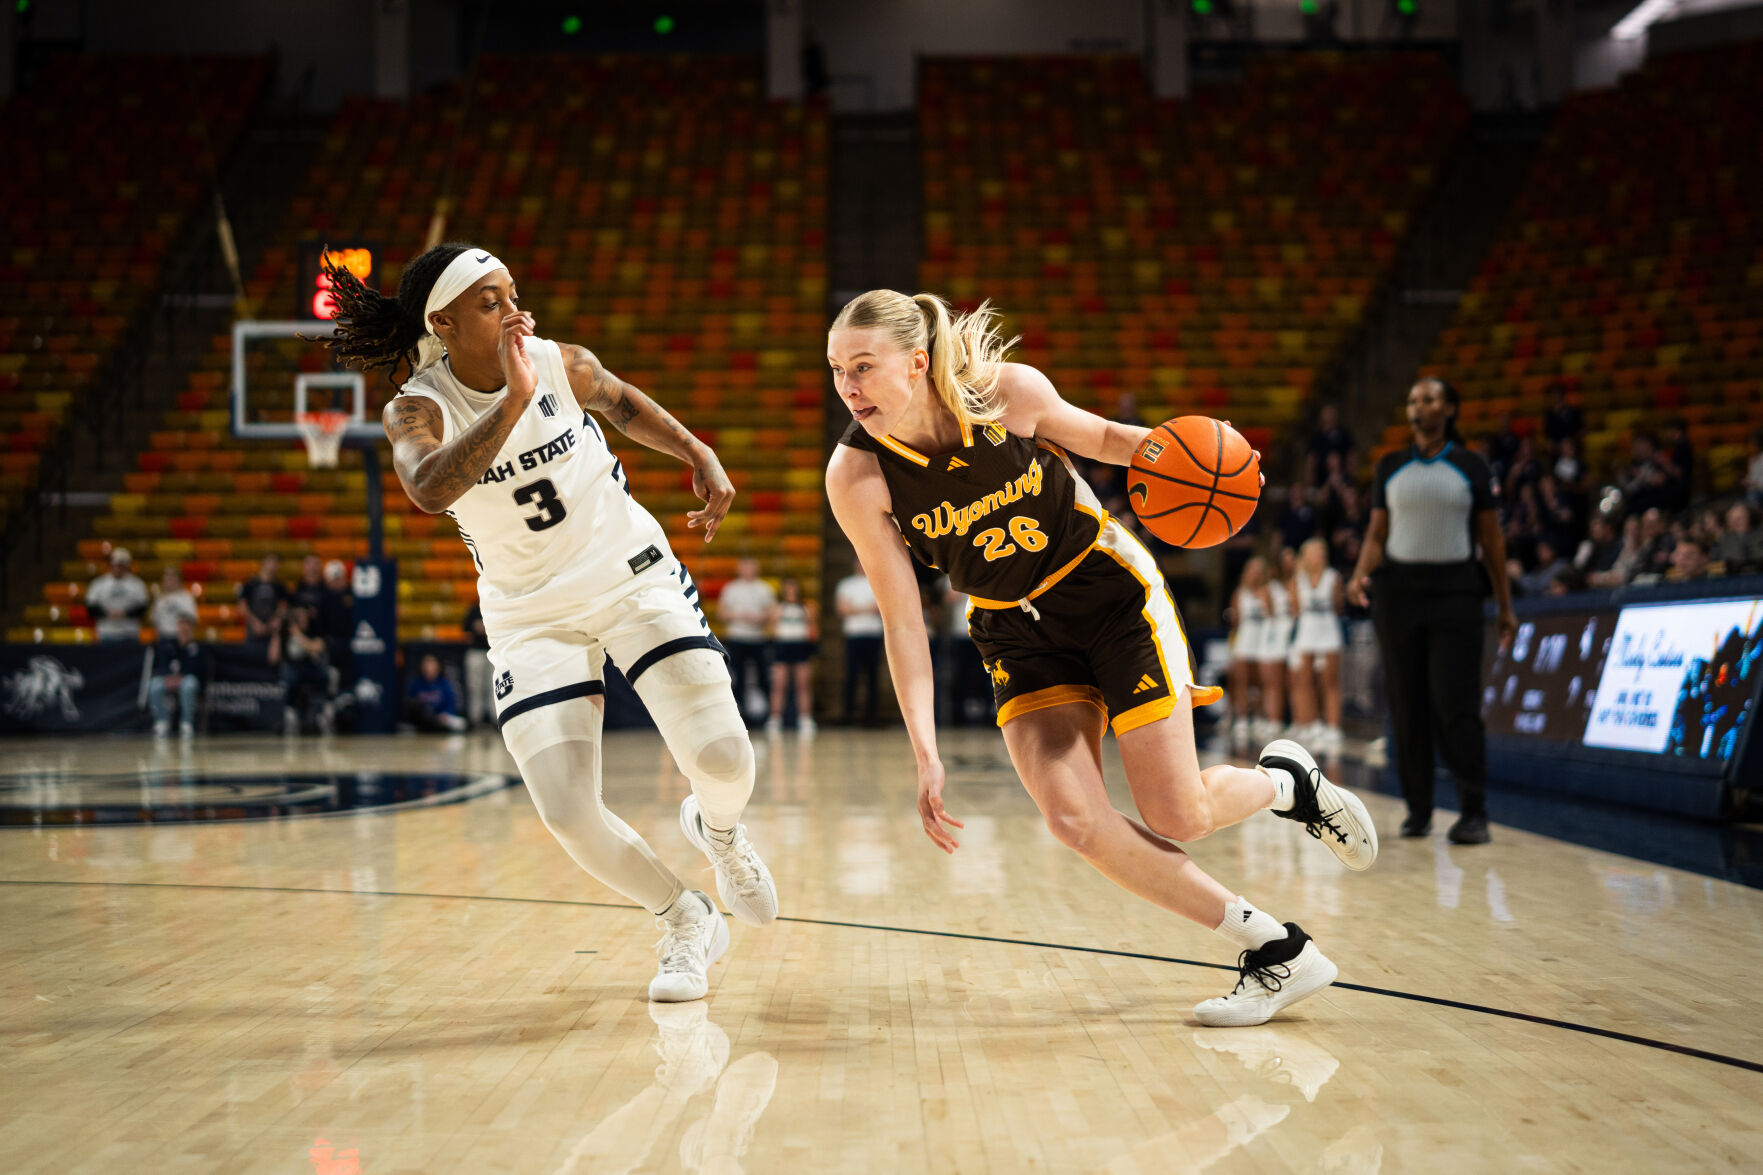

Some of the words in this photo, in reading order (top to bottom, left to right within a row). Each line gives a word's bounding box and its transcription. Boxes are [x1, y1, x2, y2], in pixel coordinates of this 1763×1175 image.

[477, 461, 516, 485] AH
[519, 428, 576, 471] STATE
[512, 477, 567, 532] 3
[912, 457, 1042, 538] Wyoming
[973, 516, 1048, 562] 26
